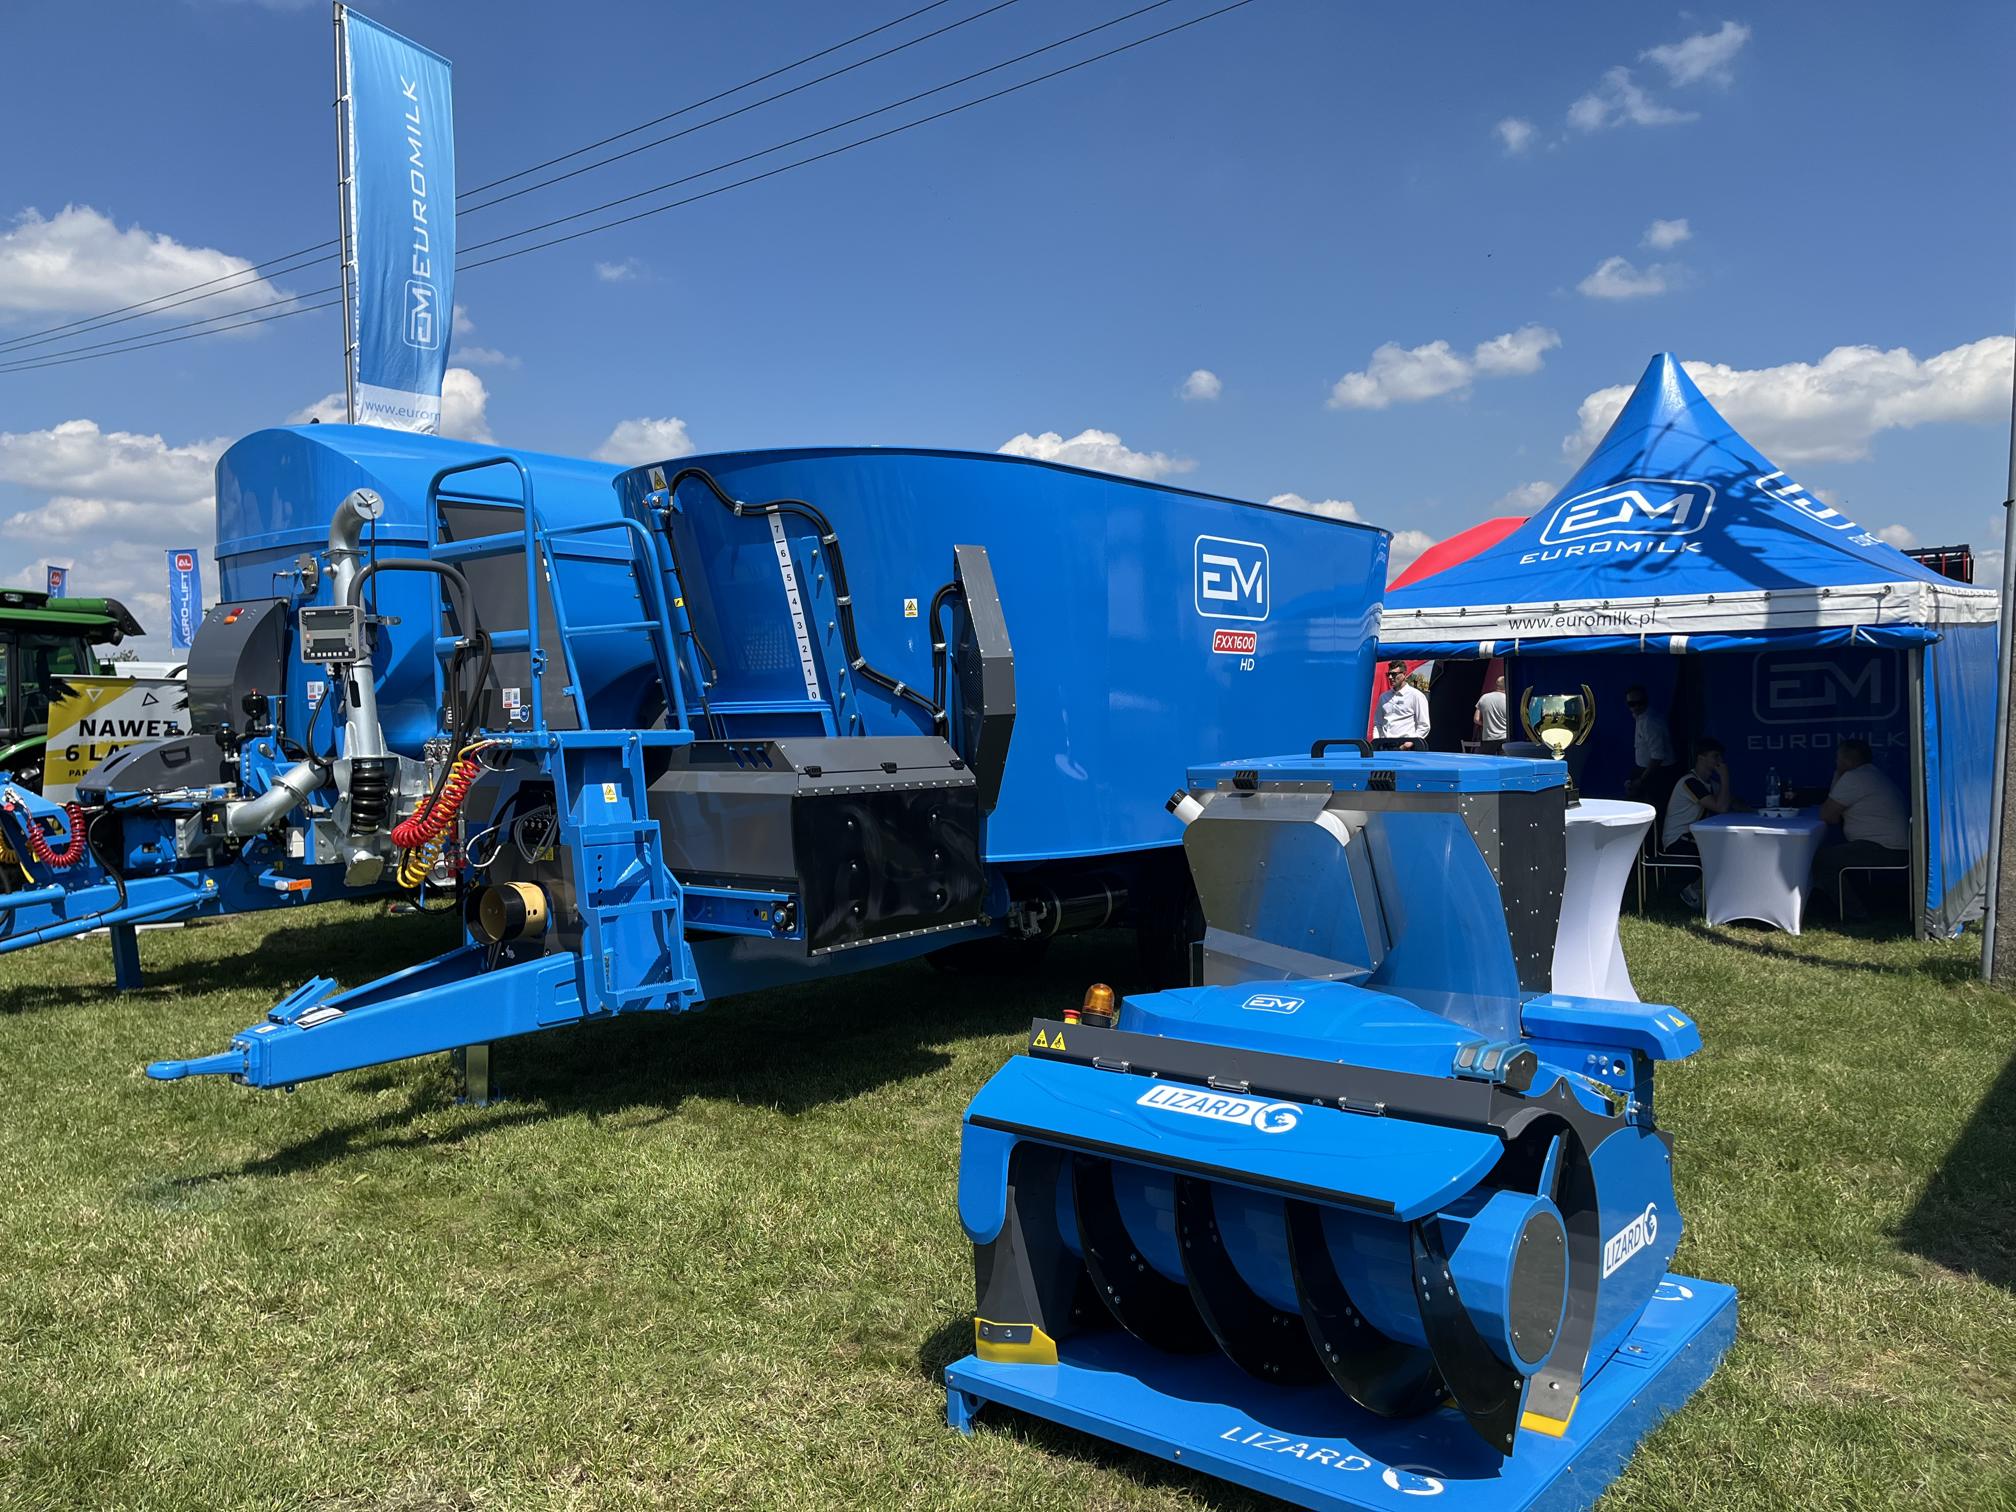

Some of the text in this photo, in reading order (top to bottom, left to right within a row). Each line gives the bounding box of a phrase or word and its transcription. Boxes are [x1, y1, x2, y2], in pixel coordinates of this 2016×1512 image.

[400, 75, 431, 279] EUROMILK
[774, 525, 780, 533] 7
[780, 549, 786, 558] 6
[1519, 540, 1704, 565] EUROMILK
[786, 573, 792, 582] 5
[181, 572, 192, 647] AGRO-LIFT
[791, 597, 798, 606] 4
[797, 621, 803, 630] 3
[1508, 610, 1656, 630] www.euromilk.pl
[802, 645, 808, 653] 2
[1214, 634, 1255, 650] FXX1600
[1240, 658, 1255, 671] HD
[811, 691, 817, 700] 0
[66, 744, 79, 761] 6
[1147, 1087, 1251, 1119] LIZARD
[1606, 1223, 1641, 1272] LIZARD
[1219, 1426, 1372, 1471] LIZARD
